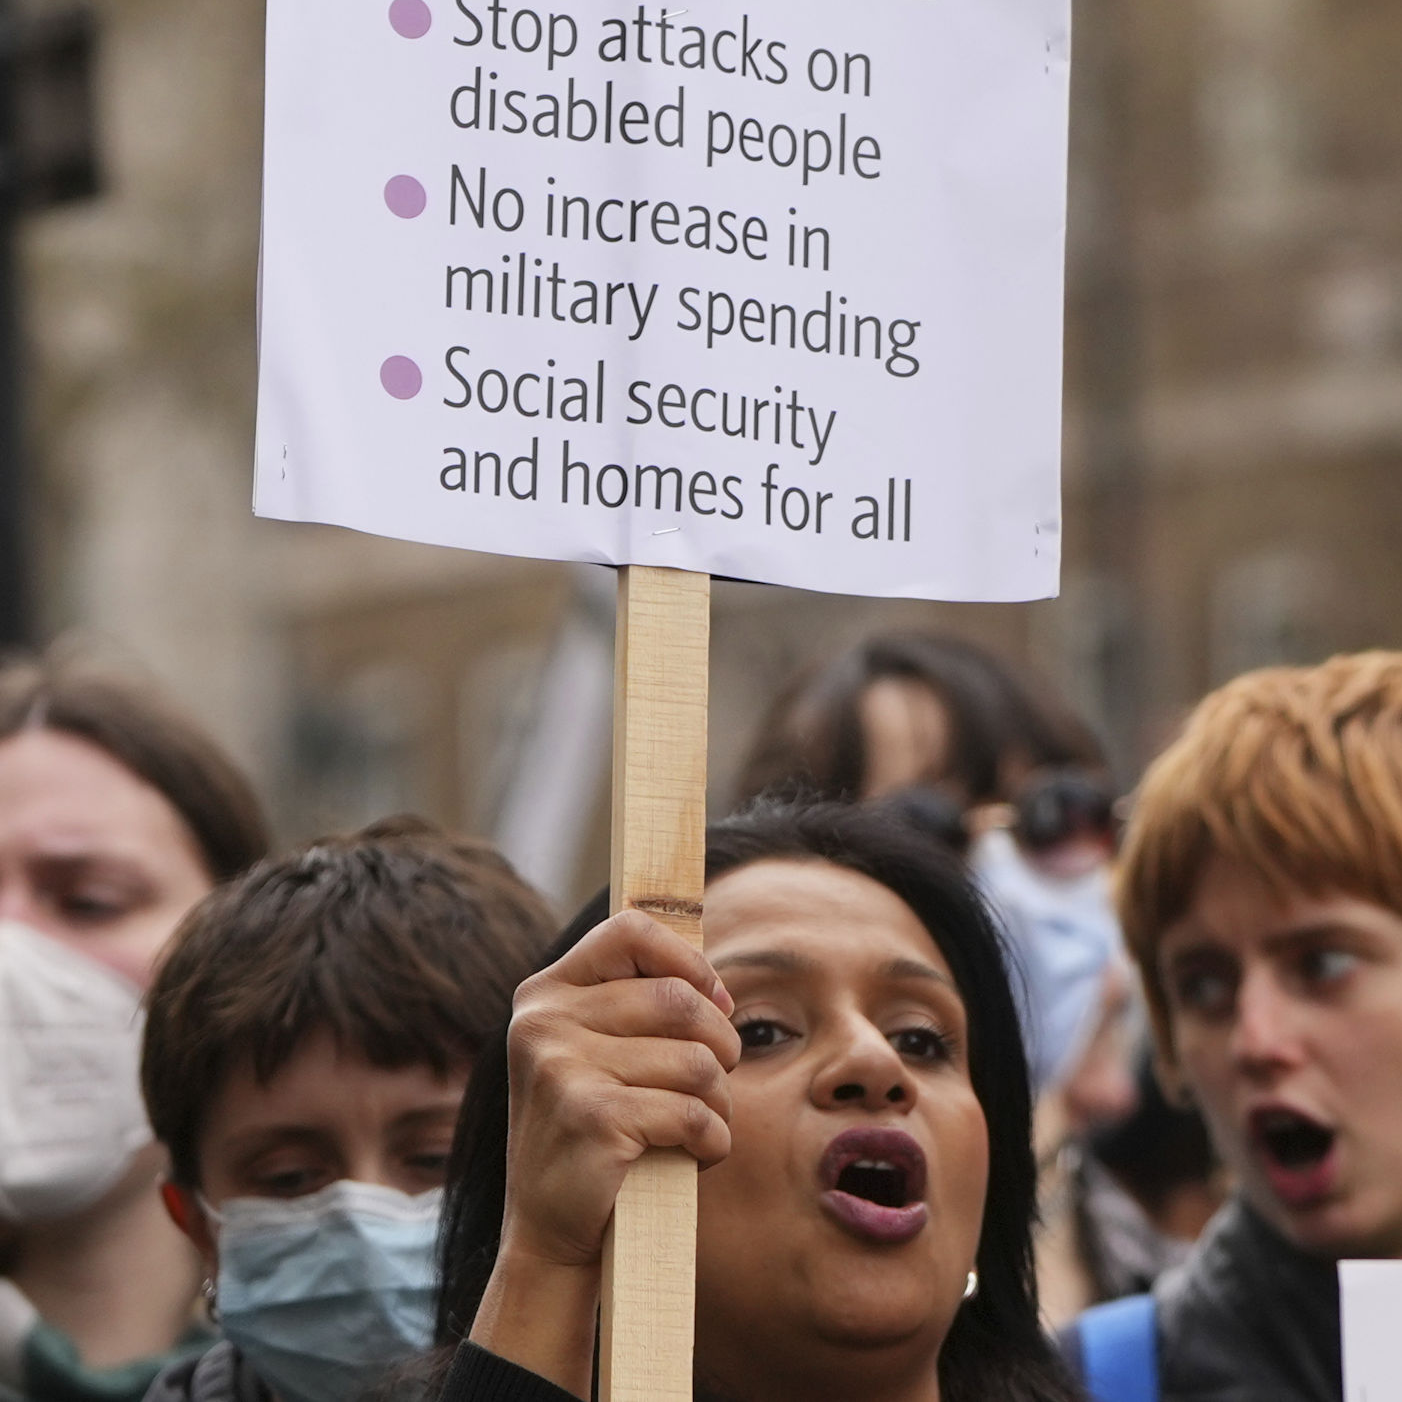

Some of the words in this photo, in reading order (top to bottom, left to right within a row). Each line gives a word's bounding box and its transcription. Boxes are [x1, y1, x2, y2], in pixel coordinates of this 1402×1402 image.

[598, 2, 789, 87] attacks
[806, 46, 871, 98] on
[449, 66, 686, 148] disabled
[706, 108, 883, 185] people
[447, 163, 525, 233] No
[545, 176, 770, 262] increase
[787, 207, 832, 271] in
[444, 251, 659, 341] military
[677, 282, 922, 378] spending
[442, 344, 605, 425] Social
[625, 374, 837, 467] security
[438, 437, 539, 501] and
[561, 440, 744, 521] homes
[761, 463, 833, 537] for
[851, 478, 912, 543] all
